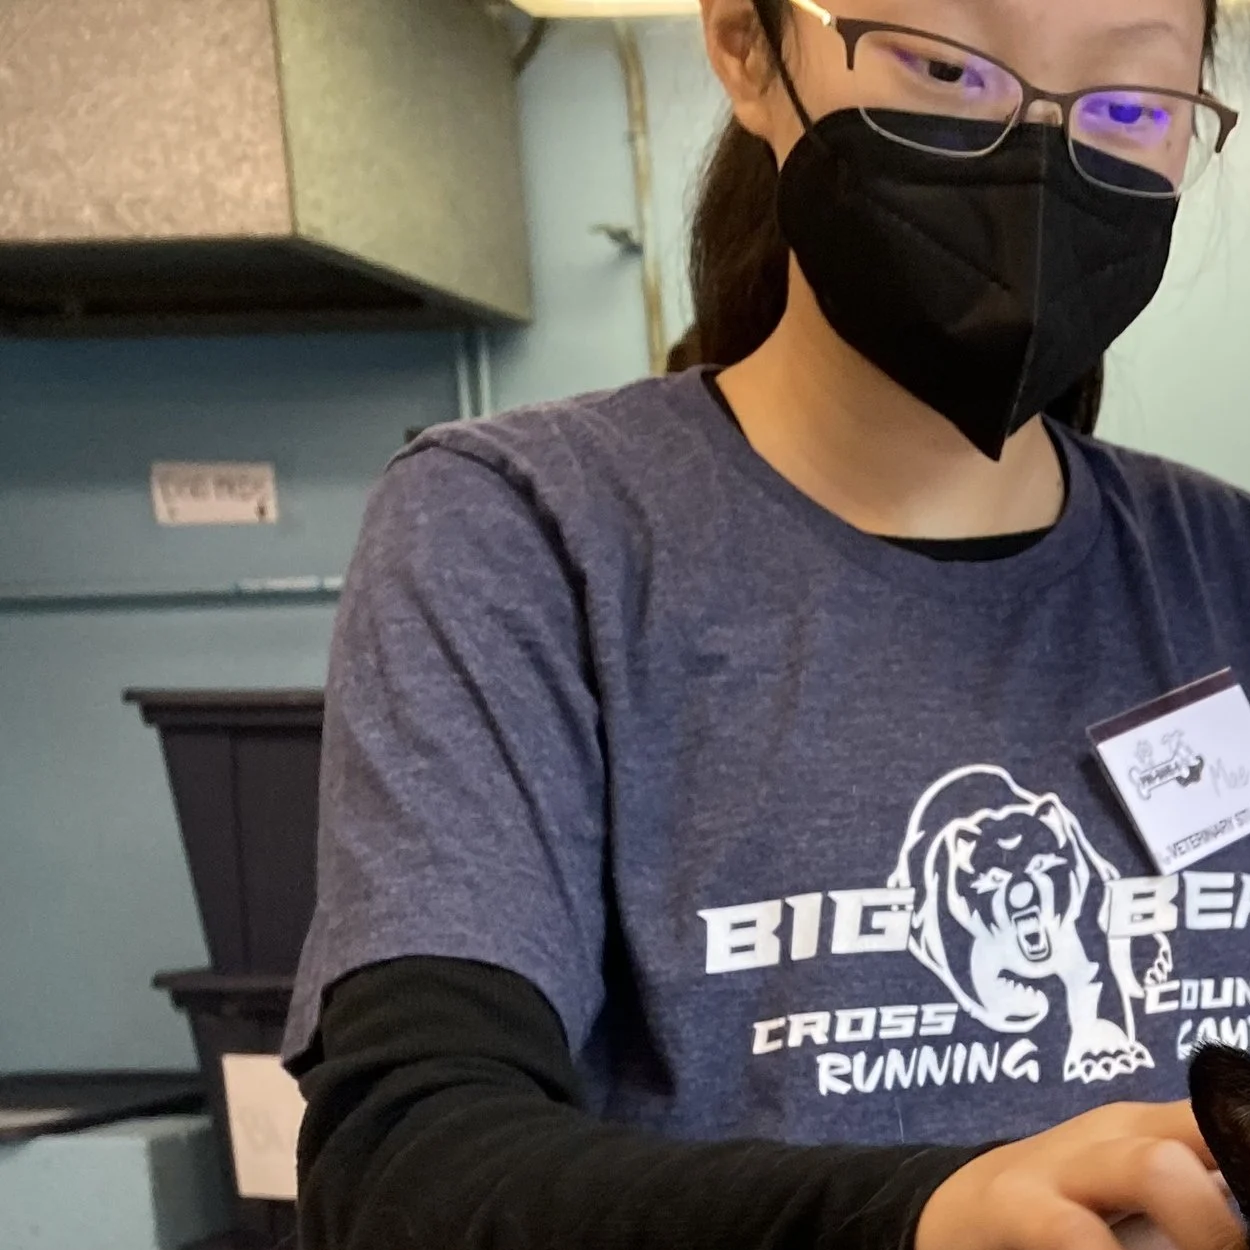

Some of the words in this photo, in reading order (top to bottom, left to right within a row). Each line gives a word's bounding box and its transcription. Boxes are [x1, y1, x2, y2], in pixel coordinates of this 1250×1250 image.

[697, 887, 915, 974] BIG
[752, 1003, 959, 1054] CROSS
[816, 1038, 1040, 1096] RUNNING
